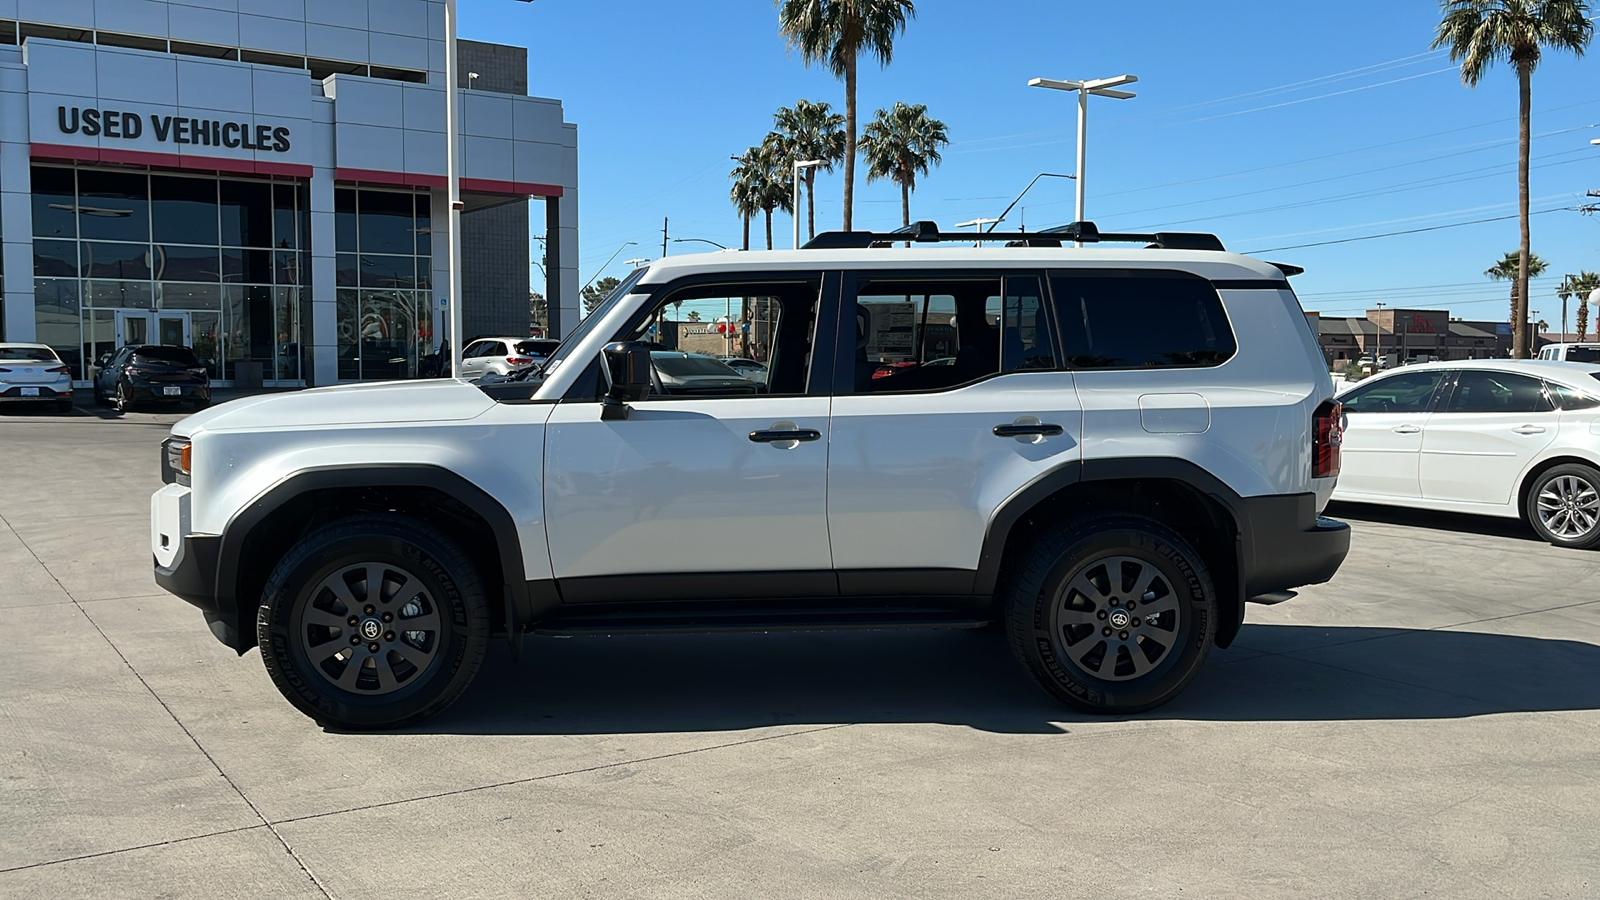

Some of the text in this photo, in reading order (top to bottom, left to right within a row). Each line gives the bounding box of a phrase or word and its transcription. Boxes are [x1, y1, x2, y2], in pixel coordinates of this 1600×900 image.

[58, 106, 291, 152] USED VEHICLES
[422, 557, 466, 623] MICHELIN
[1156, 543, 1203, 598] MICHELIN
[272, 636, 318, 702] MICHELIN
[1040, 640, 1086, 695] MICHELIN
